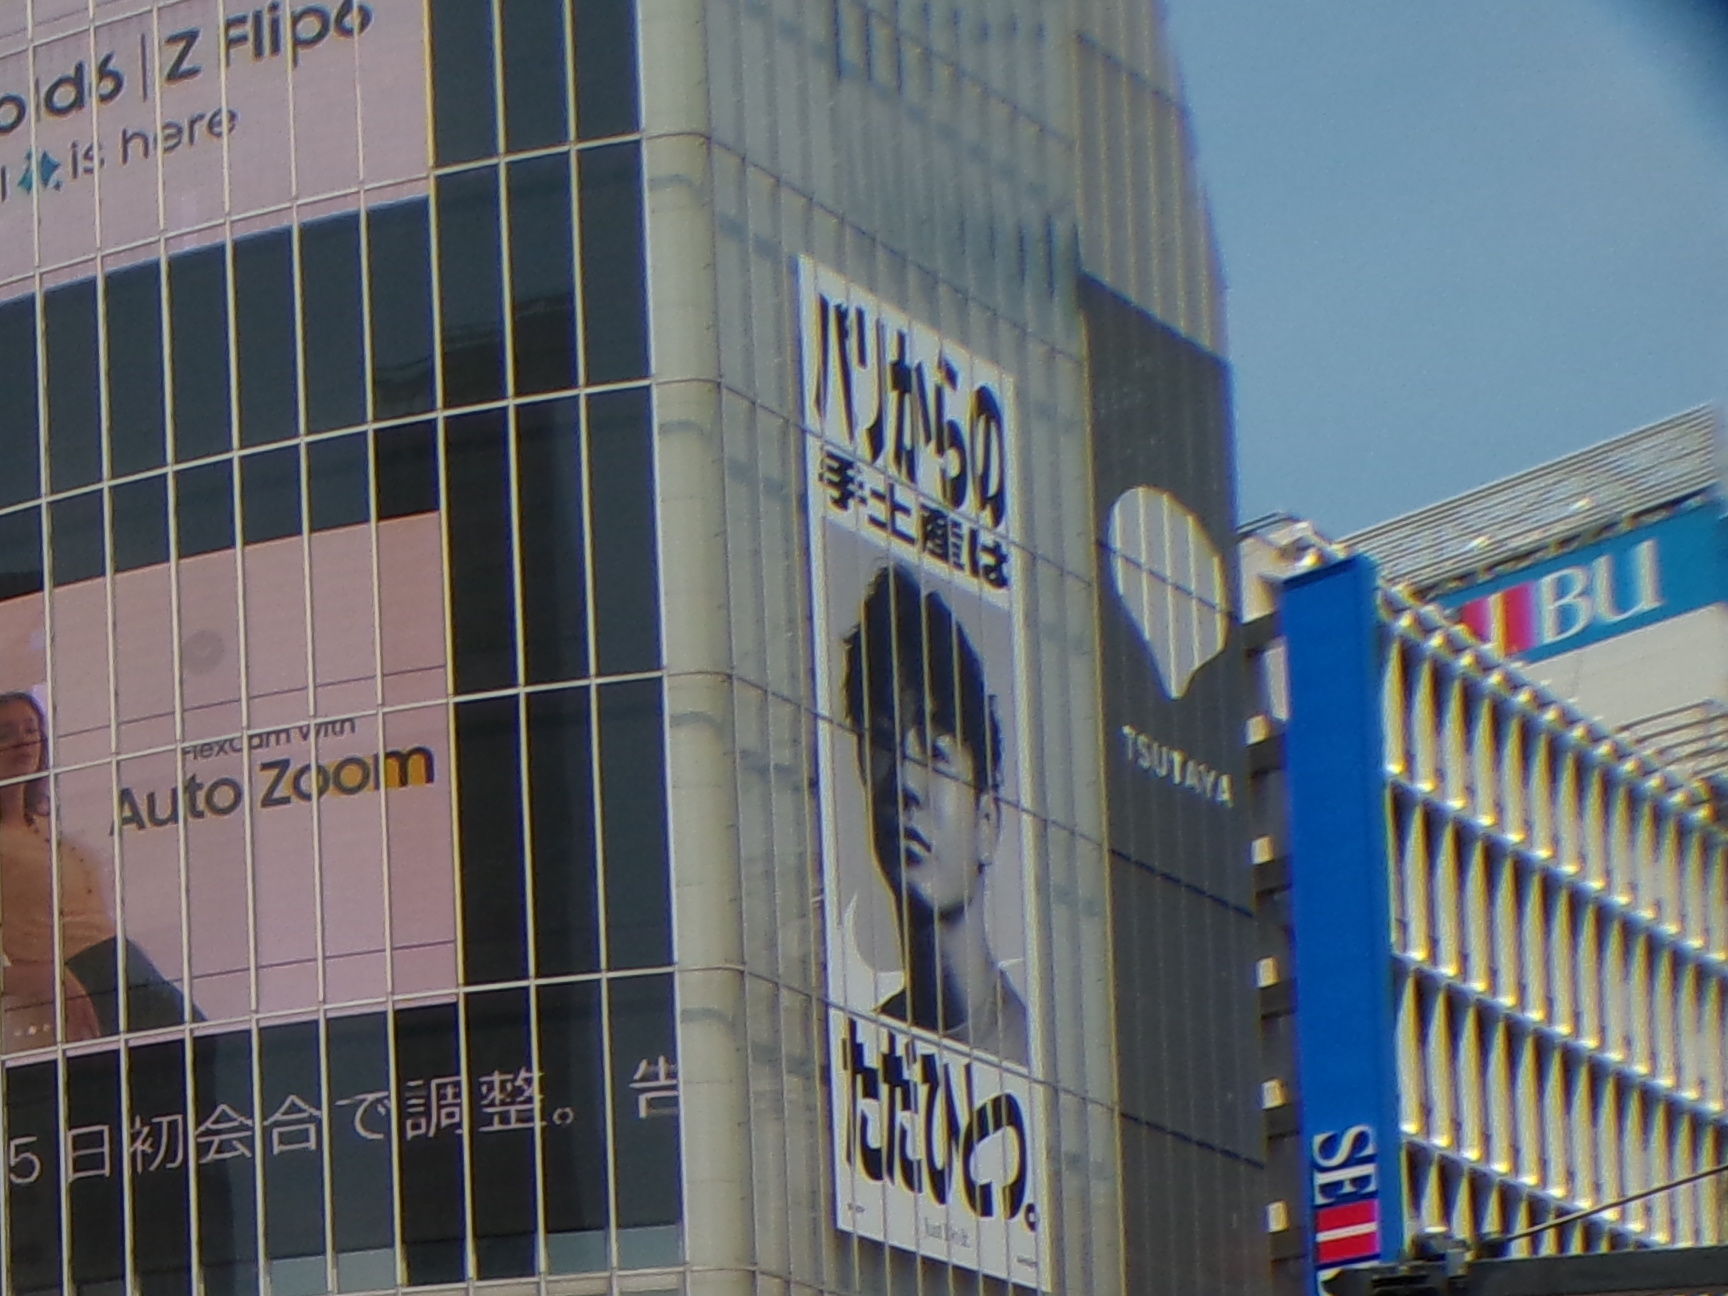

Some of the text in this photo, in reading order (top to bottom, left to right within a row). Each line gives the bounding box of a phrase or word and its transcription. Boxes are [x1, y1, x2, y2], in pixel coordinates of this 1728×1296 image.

[164, 26, 203, 82] Z
[121, 106, 240, 165] here
[109, 744, 437, 838] Auto Zoom
[1120, 724, 1235, 808] TSUTAYA
